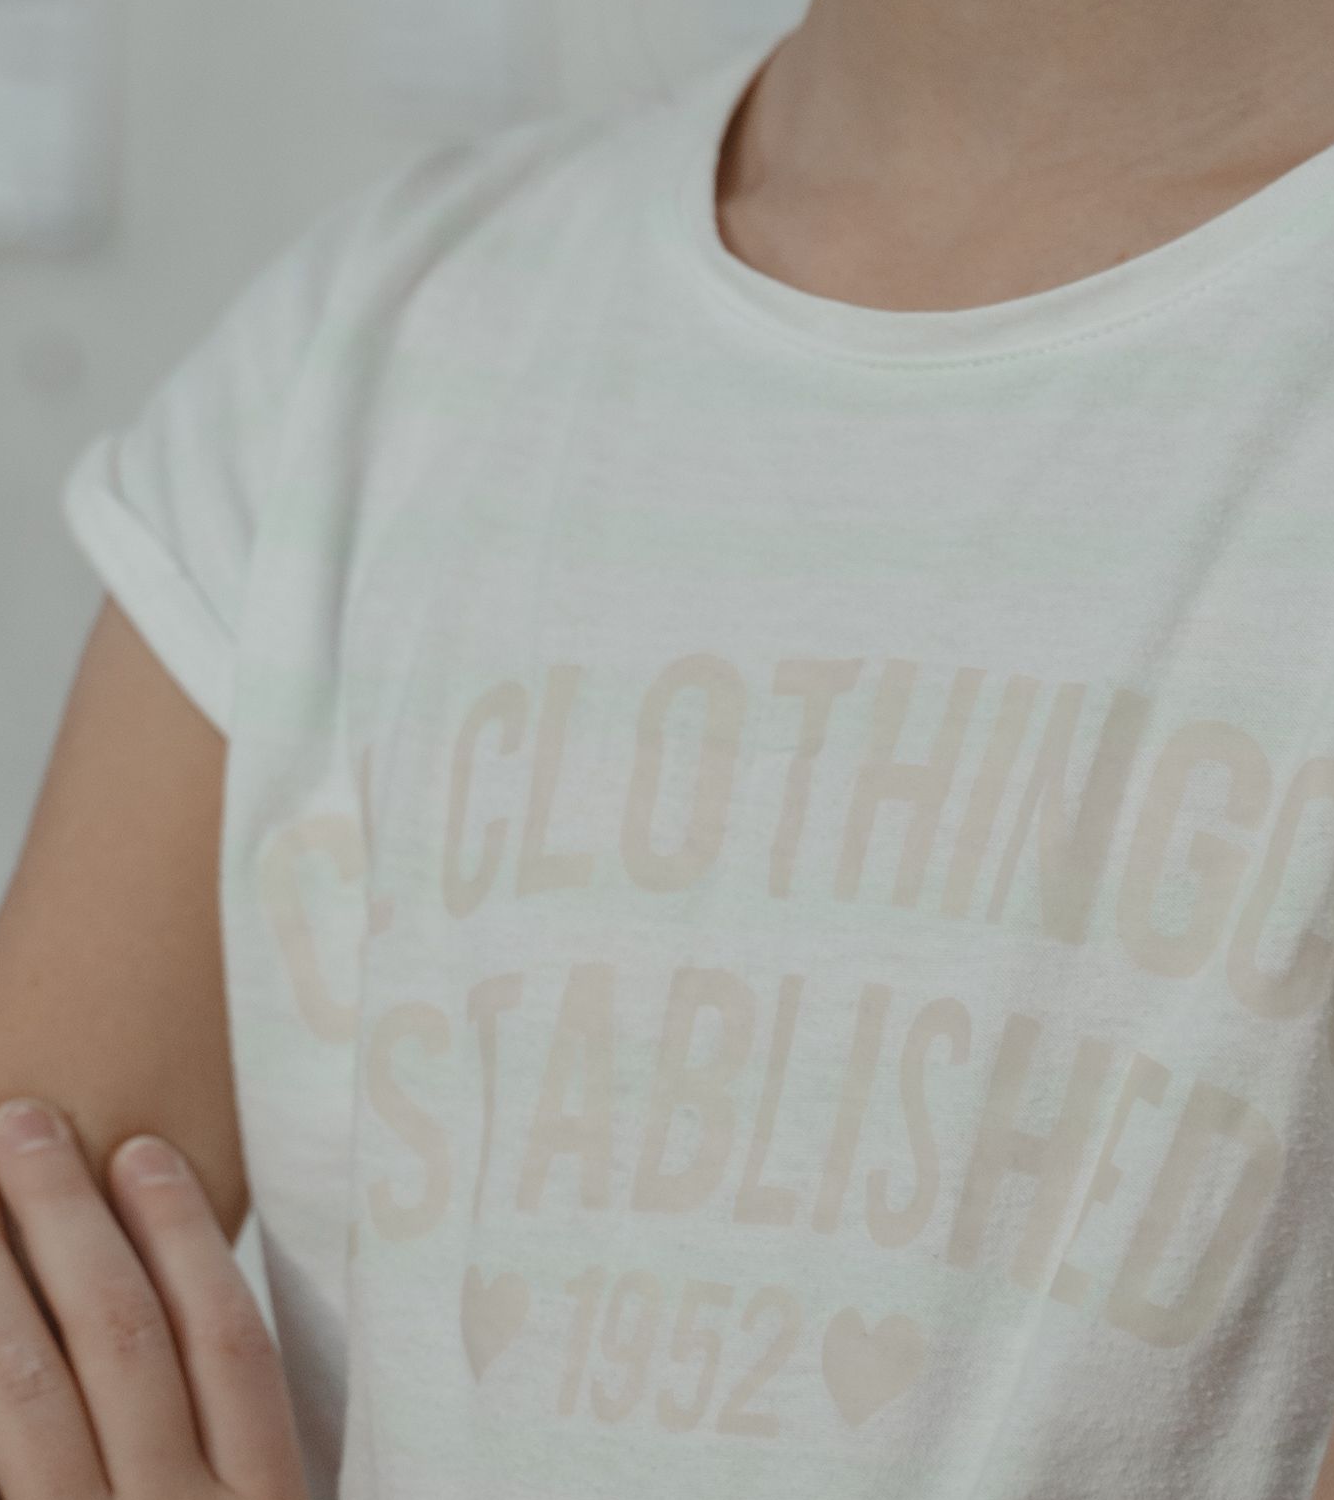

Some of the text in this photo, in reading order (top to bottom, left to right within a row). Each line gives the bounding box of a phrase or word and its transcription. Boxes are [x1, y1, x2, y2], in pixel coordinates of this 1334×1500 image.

[442, 652, 1273, 980] CLOTHING
[349, 962, 1285, 1350] STABLISHED
[557, 1263, 805, 1440] 1952
